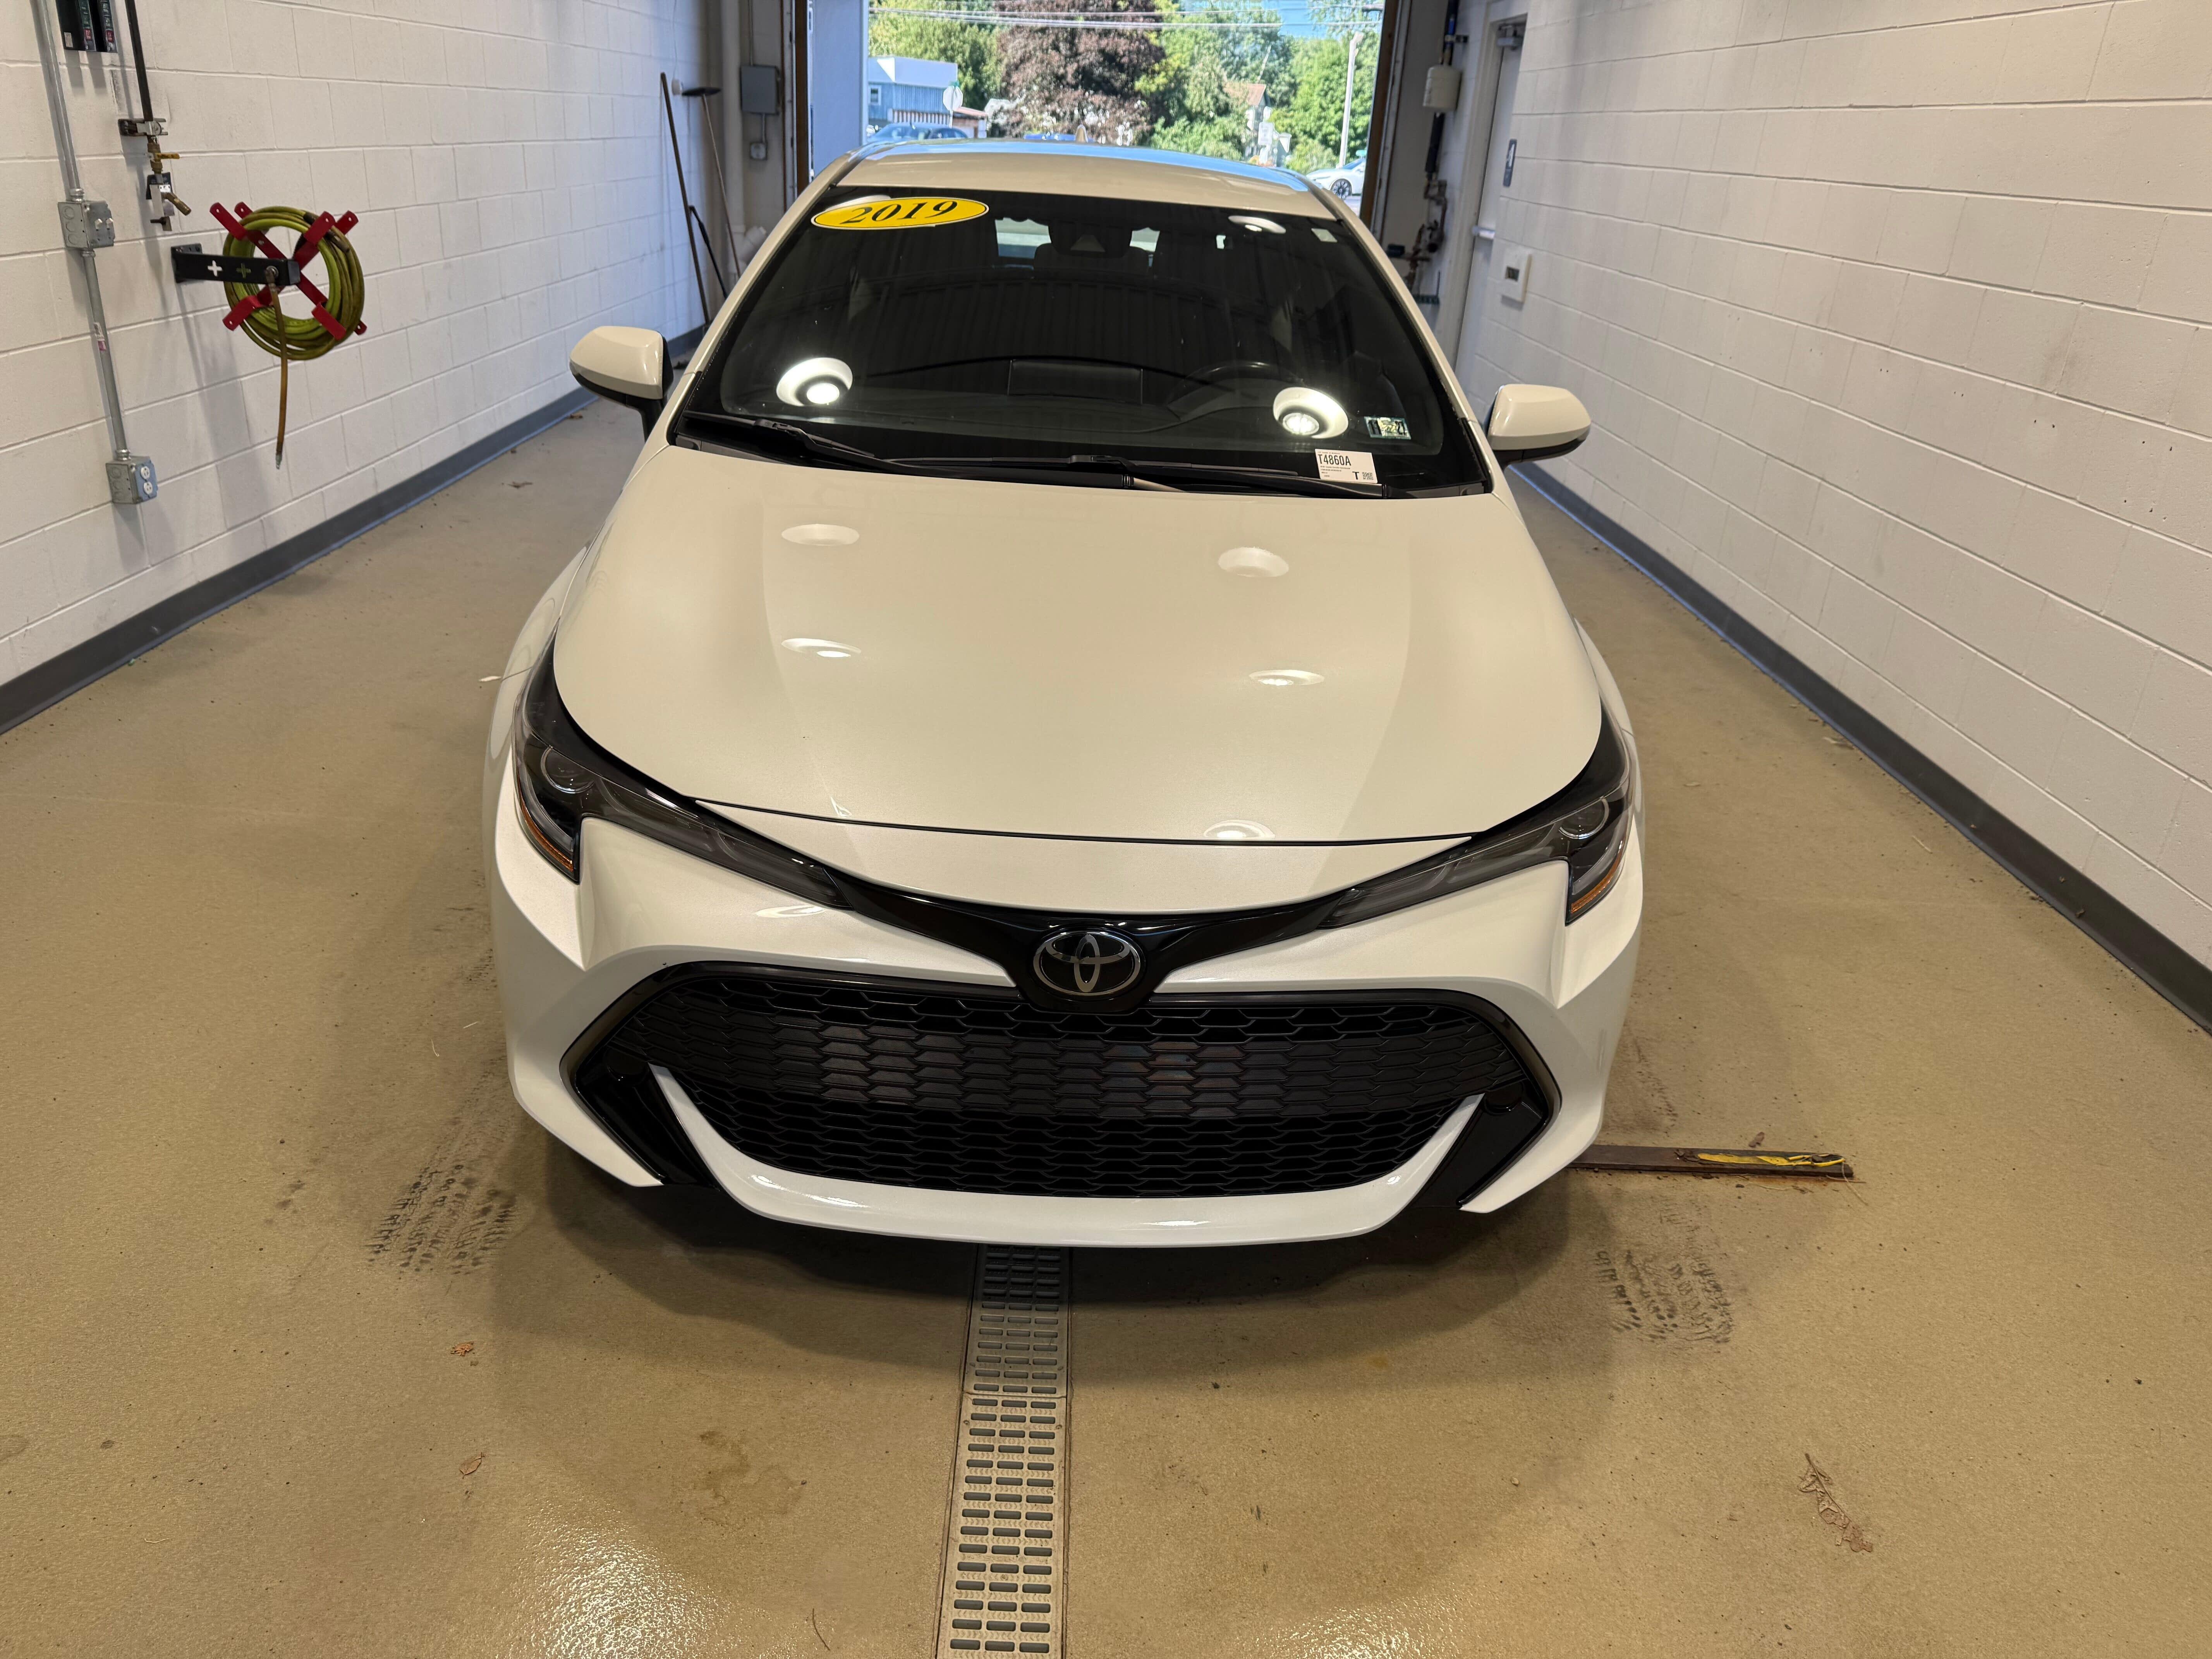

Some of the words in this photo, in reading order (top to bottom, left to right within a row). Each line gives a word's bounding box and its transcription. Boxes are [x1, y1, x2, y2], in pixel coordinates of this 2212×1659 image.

[840, 201, 958, 225] 2019
[1318, 454, 1352, 466] T4860A
[1352, 471, 1359, 480] T
